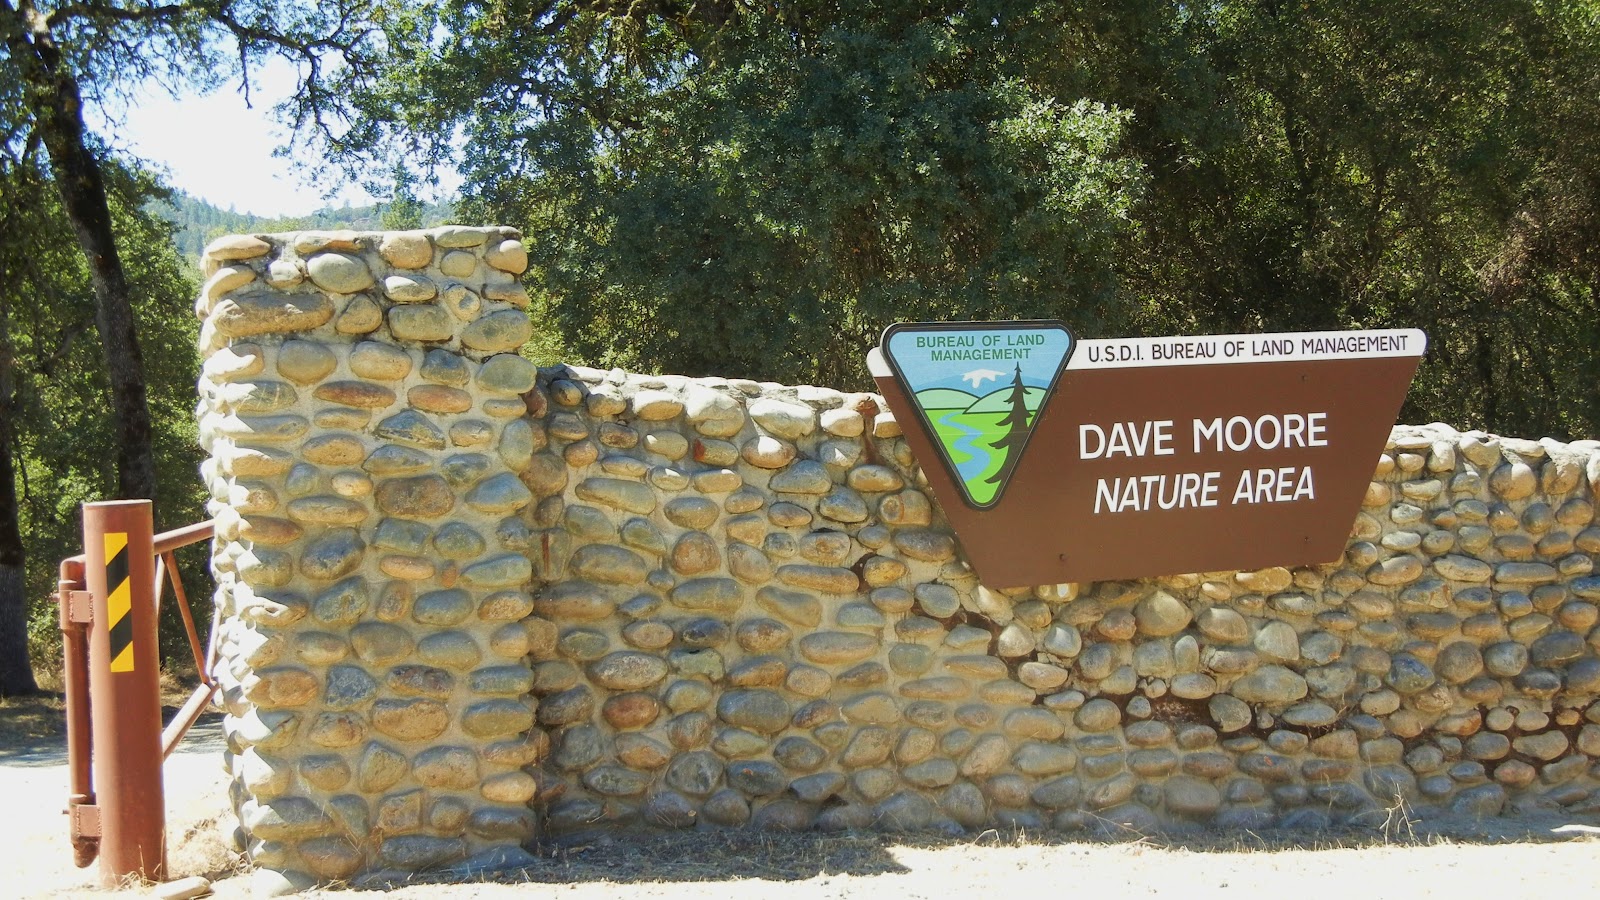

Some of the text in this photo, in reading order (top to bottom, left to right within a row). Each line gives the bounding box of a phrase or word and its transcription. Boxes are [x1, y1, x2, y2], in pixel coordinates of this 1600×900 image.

[916, 334, 1045, 348] BUREAU OF LAND
[930, 348, 1032, 362] MANAGEMENT
[1087, 335, 1409, 363] U.S.D.I. BUREAU OF LAND MANAGEMENT
[1078, 412, 1328, 460] DAVE MOORE
[1093, 465, 1316, 514] NATURE AREA
